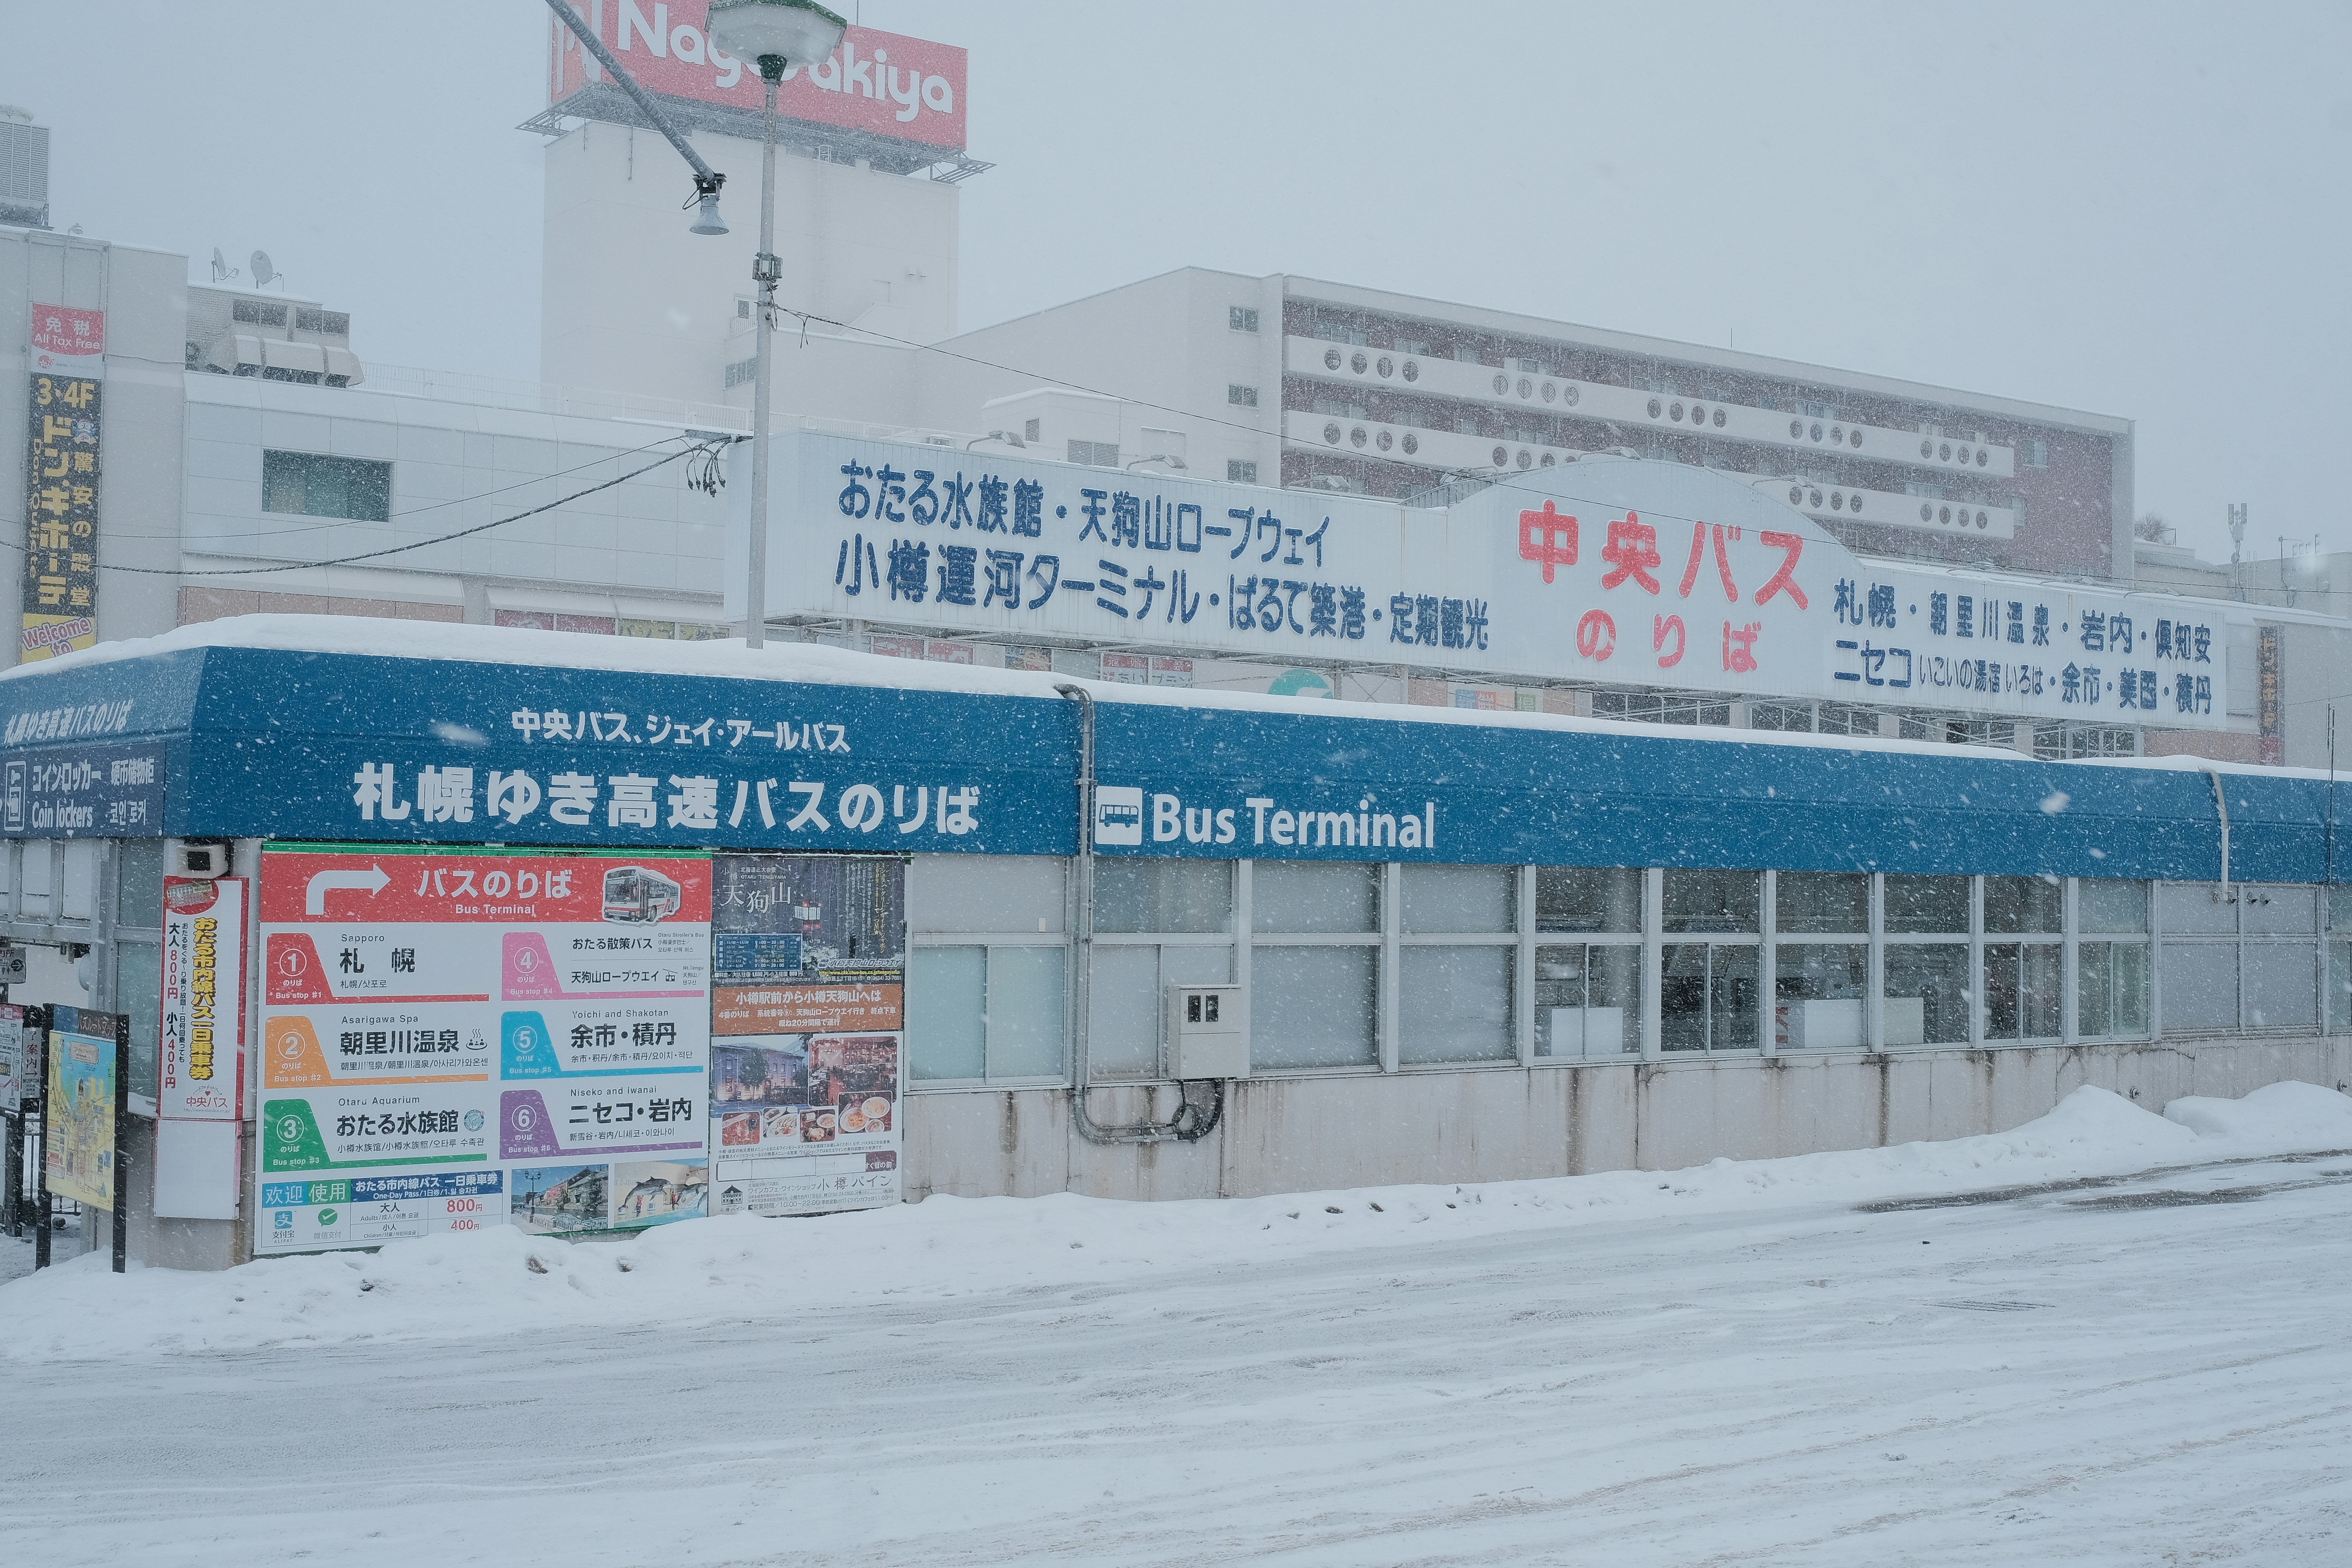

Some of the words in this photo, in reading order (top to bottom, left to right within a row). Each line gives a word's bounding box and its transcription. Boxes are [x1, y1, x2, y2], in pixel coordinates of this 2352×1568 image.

[46, 316, 90, 337] 免税
[34, 333, 49, 343] All
[52, 335, 72, 348] Tax
[75, 338, 101, 349] Free
[838, 458, 1330, 568] おたる水族館・天狗山ロープウェイ
[70, 452, 94, 606] 驚安の殿堂
[1517, 499, 1809, 610] 中央バス
[23, 618, 91, 650] Welcome
[1576, 608, 1763, 673] のりば
[53, 641, 72, 656] to
[4, 699, 134, 744] 札幌ゆき高速バスのりば
[32, 759, 101, 793] コインロッカー
[354, 762, 981, 835] 札幌ゆき高速バスのりば
[32, 800, 53, 828] Coin
[56, 798, 93, 828] lockers
[1153, 793, 1236, 844] Bus
[1245, 797, 1434, 848] Terminal
[418, 868, 572, 899] バスのりば
[720, 882, 791, 913] 天狗山
[456, 904, 478, 914] Bus
[484, 904, 535, 915] Terminal
[168, 922, 180, 947] 大人
[341, 933, 385, 943] Sapporo
[572, 936, 653, 950] おたる散策バス
[340, 947, 415, 974] 札幌
[167, 949, 178, 999] 800円
[571, 969, 660, 984] 天狗山ロープウエイ
[189, 917, 218, 1080] おたる市内線バス一日乗車券
[735, 989, 882, 1005] 小樽駅前から小樽天狗山へは
[341, 1015, 395, 1025] Asarigawa
[399, 1014, 419, 1024] Spa
[571, 1010, 602, 1019] Yoichi
[605, 1009, 622, 1018] and
[625, 1009, 669, 1018] Shakotan
[718, 1010, 750, 1019] 4番のりば
[796, 1006, 865, 1017] 天狗山ロープウエイ行き
[870, 1006, 896, 1015] 終点下車
[778, 1018, 841, 1027] 概ね20分間隔で運行
[166, 1012, 178, 1037] 小人
[570, 1022, 677, 1049] 余市・積丹
[339, 1029, 460, 1057] 朝里川温泉
[165, 1038, 176, 1089] 400円
[186, 1096, 228, 1108] 中央バス
[338, 1098, 368, 1107] Otaru
[371, 1096, 420, 1106] Aquarium
[570, 1088, 602, 1097] Niseko
[606, 1087, 623, 1096] and
[627, 1086, 657, 1094] Iwanai
[569, 1097, 692, 1124] ニセコ・岩内
[336, 1109, 459, 1137] おたる水族館
[309, 1156, 320, 1164] #3
[355, 1177, 440, 1192] おたる市内線バス
[444, 1172, 498, 1187] 一日乗車券
[817, 1175, 892, 1191] 小樽バイン
[373, 1192, 403, 1200] One-Day
[380, 1202, 400, 1213] 大人
[447, 1199, 483, 1213] 800円
[272, 1230, 295, 1239] 支付宝
[313, 1231, 342, 1240] 微信支付
[450, 1219, 480, 1231] 400円
